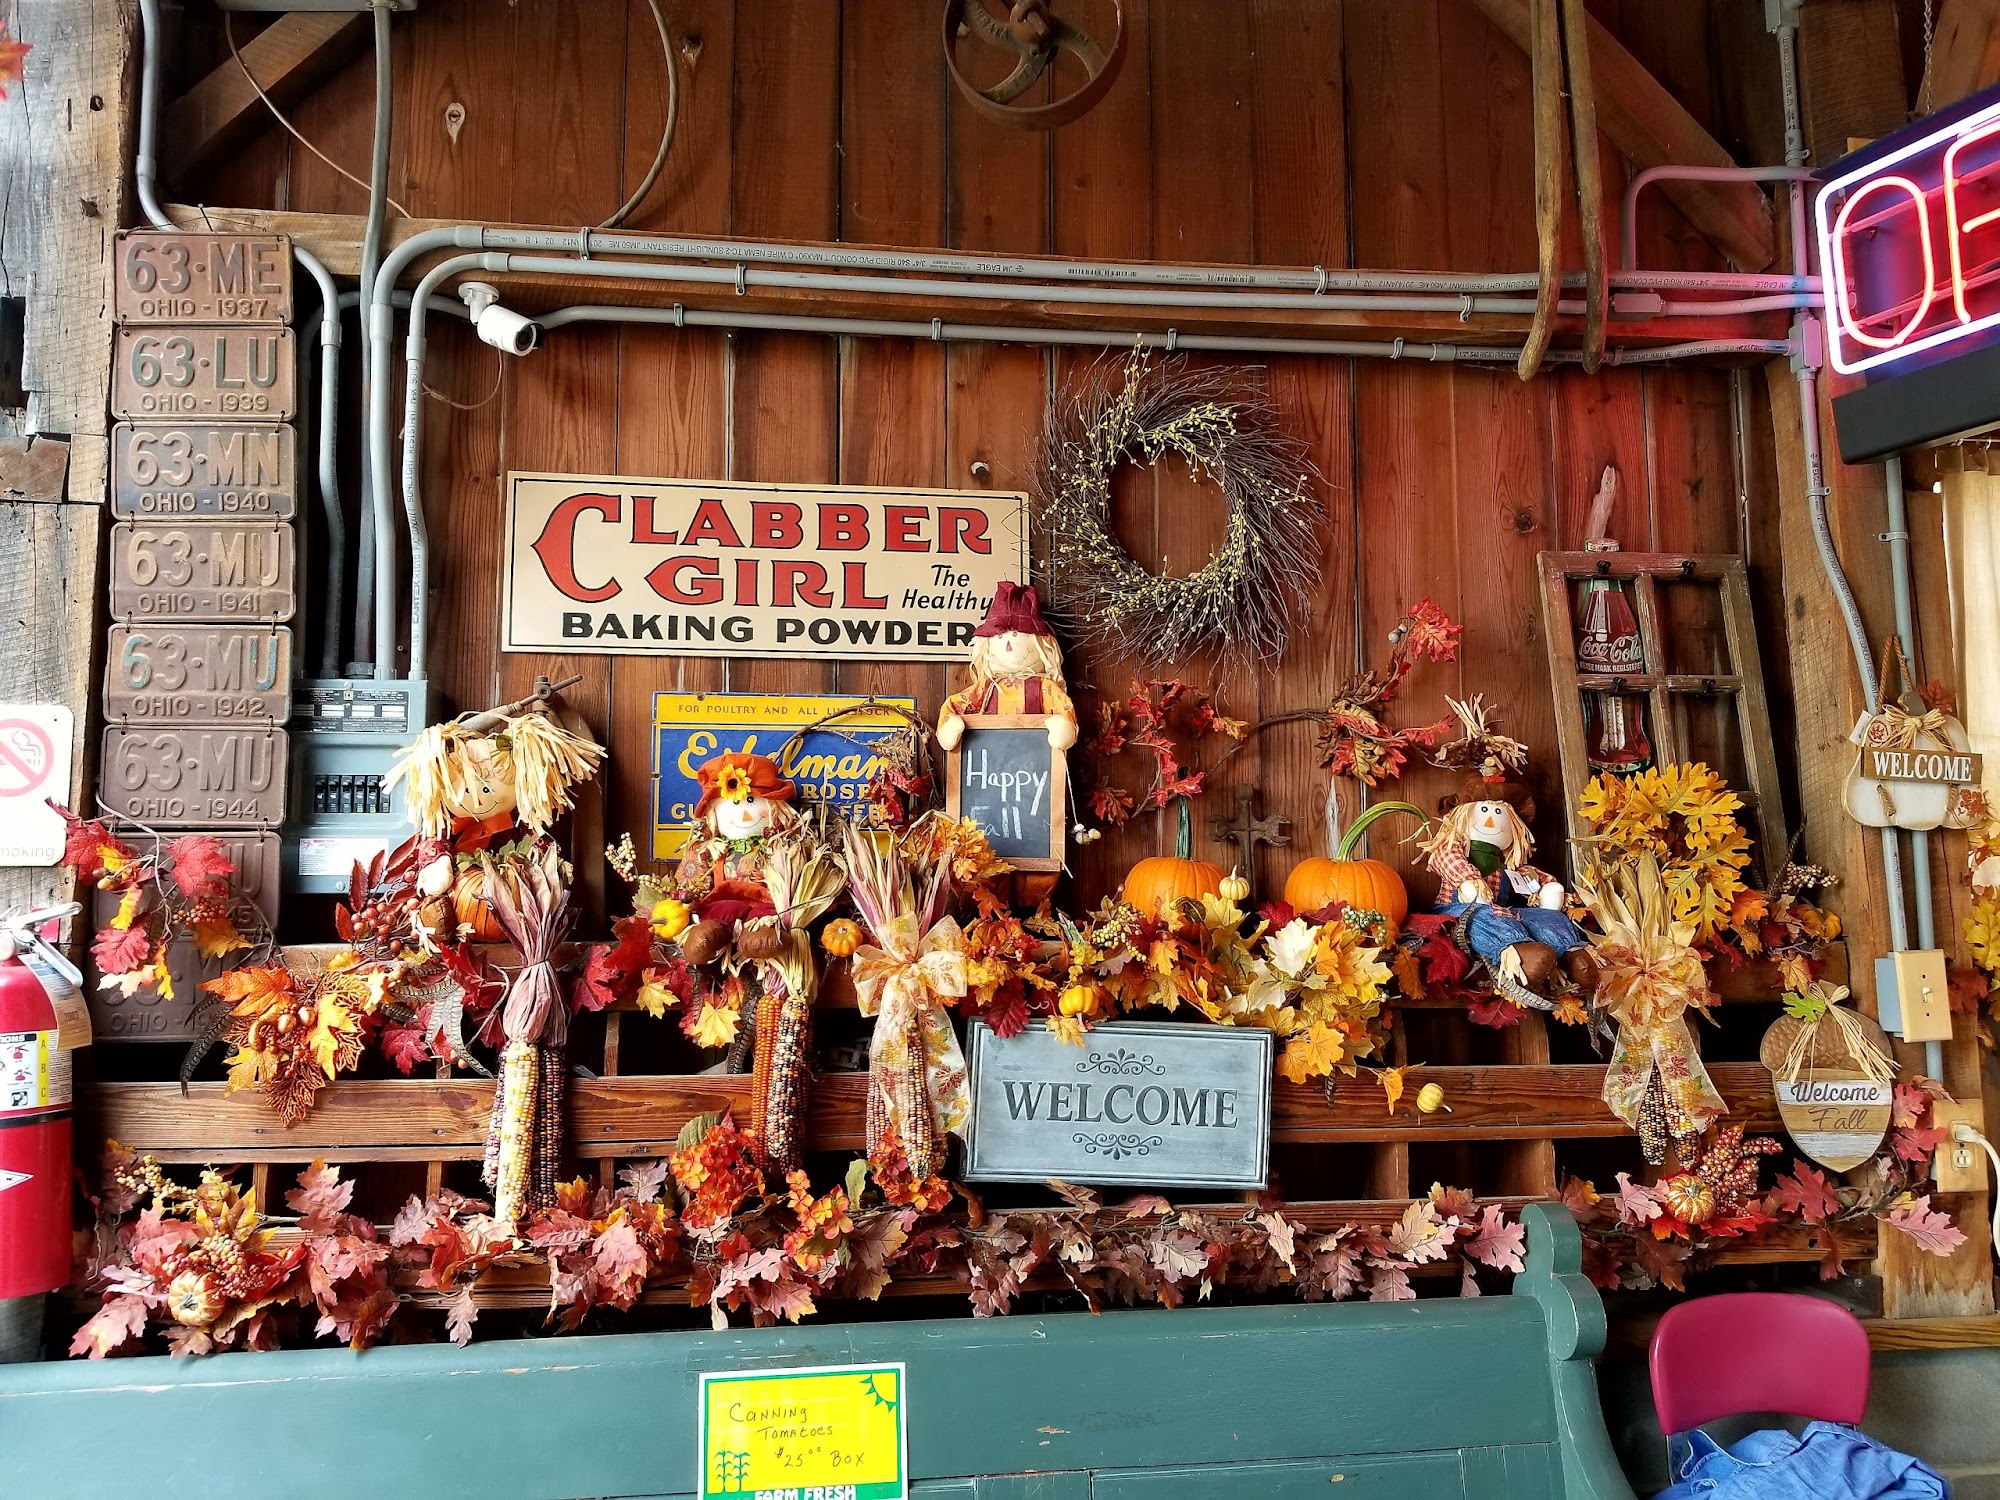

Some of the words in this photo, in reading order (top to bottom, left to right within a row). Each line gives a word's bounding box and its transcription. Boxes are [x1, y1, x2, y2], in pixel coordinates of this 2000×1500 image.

[608, 240, 620, 248] ME
[642, 242, 685, 252] RESISTANT
[686, 245, 724, 254] SUNLIGHT
[725, 247, 742, 256] TC-2
[743, 249, 766, 257] NEMA
[767, 251, 787, 259] WIRE
[977, 263, 1001, 272] EAGLE
[140, 299, 196, 317] OHIO
[217, 299, 268, 317] 1937
[142, 393, 196, 412] OHIO
[218, 393, 268, 412] 1939
[407, 409, 416, 455] RESISTANT
[405, 459, 415, 503] SUNLIGHT
[139, 492, 196, 511] OHIO
[218, 492, 271, 511] 1940
[530, 493, 992, 604] CLABBER
[645, 555, 888, 611] GIRL
[931, 564, 970, 587] The
[137, 593, 195, 613] OHIO
[216, 592, 262, 612] 1941
[901, 588, 994, 620] Healthy
[562, 612, 754, 643] BAKING
[776, 618, 976, 647] POWDER
[132, 696, 191, 716] OHIO
[212, 696, 265, 717] 1942
[678, 704, 700, 713] FOR
[706, 705, 757, 715] POULTRY
[764, 706, 788, 715] AND
[798, 707, 819, 716] ALL
[1872, 751, 1972, 782] WELCOME
[966, 748, 1048, 816] Happy
[127, 798, 185, 818] OHIO
[206, 798, 258, 818] 1944
[970, 804, 1023, 840] Fall
[41, 1039, 46, 1049] A
[1790, 1081, 1880, 1102] Welcome
[1001, 1079, 1239, 1129] WELCOME
[1808, 1106, 1869, 1131] Fall
[804, 1484, 857, 1500] FRESH
